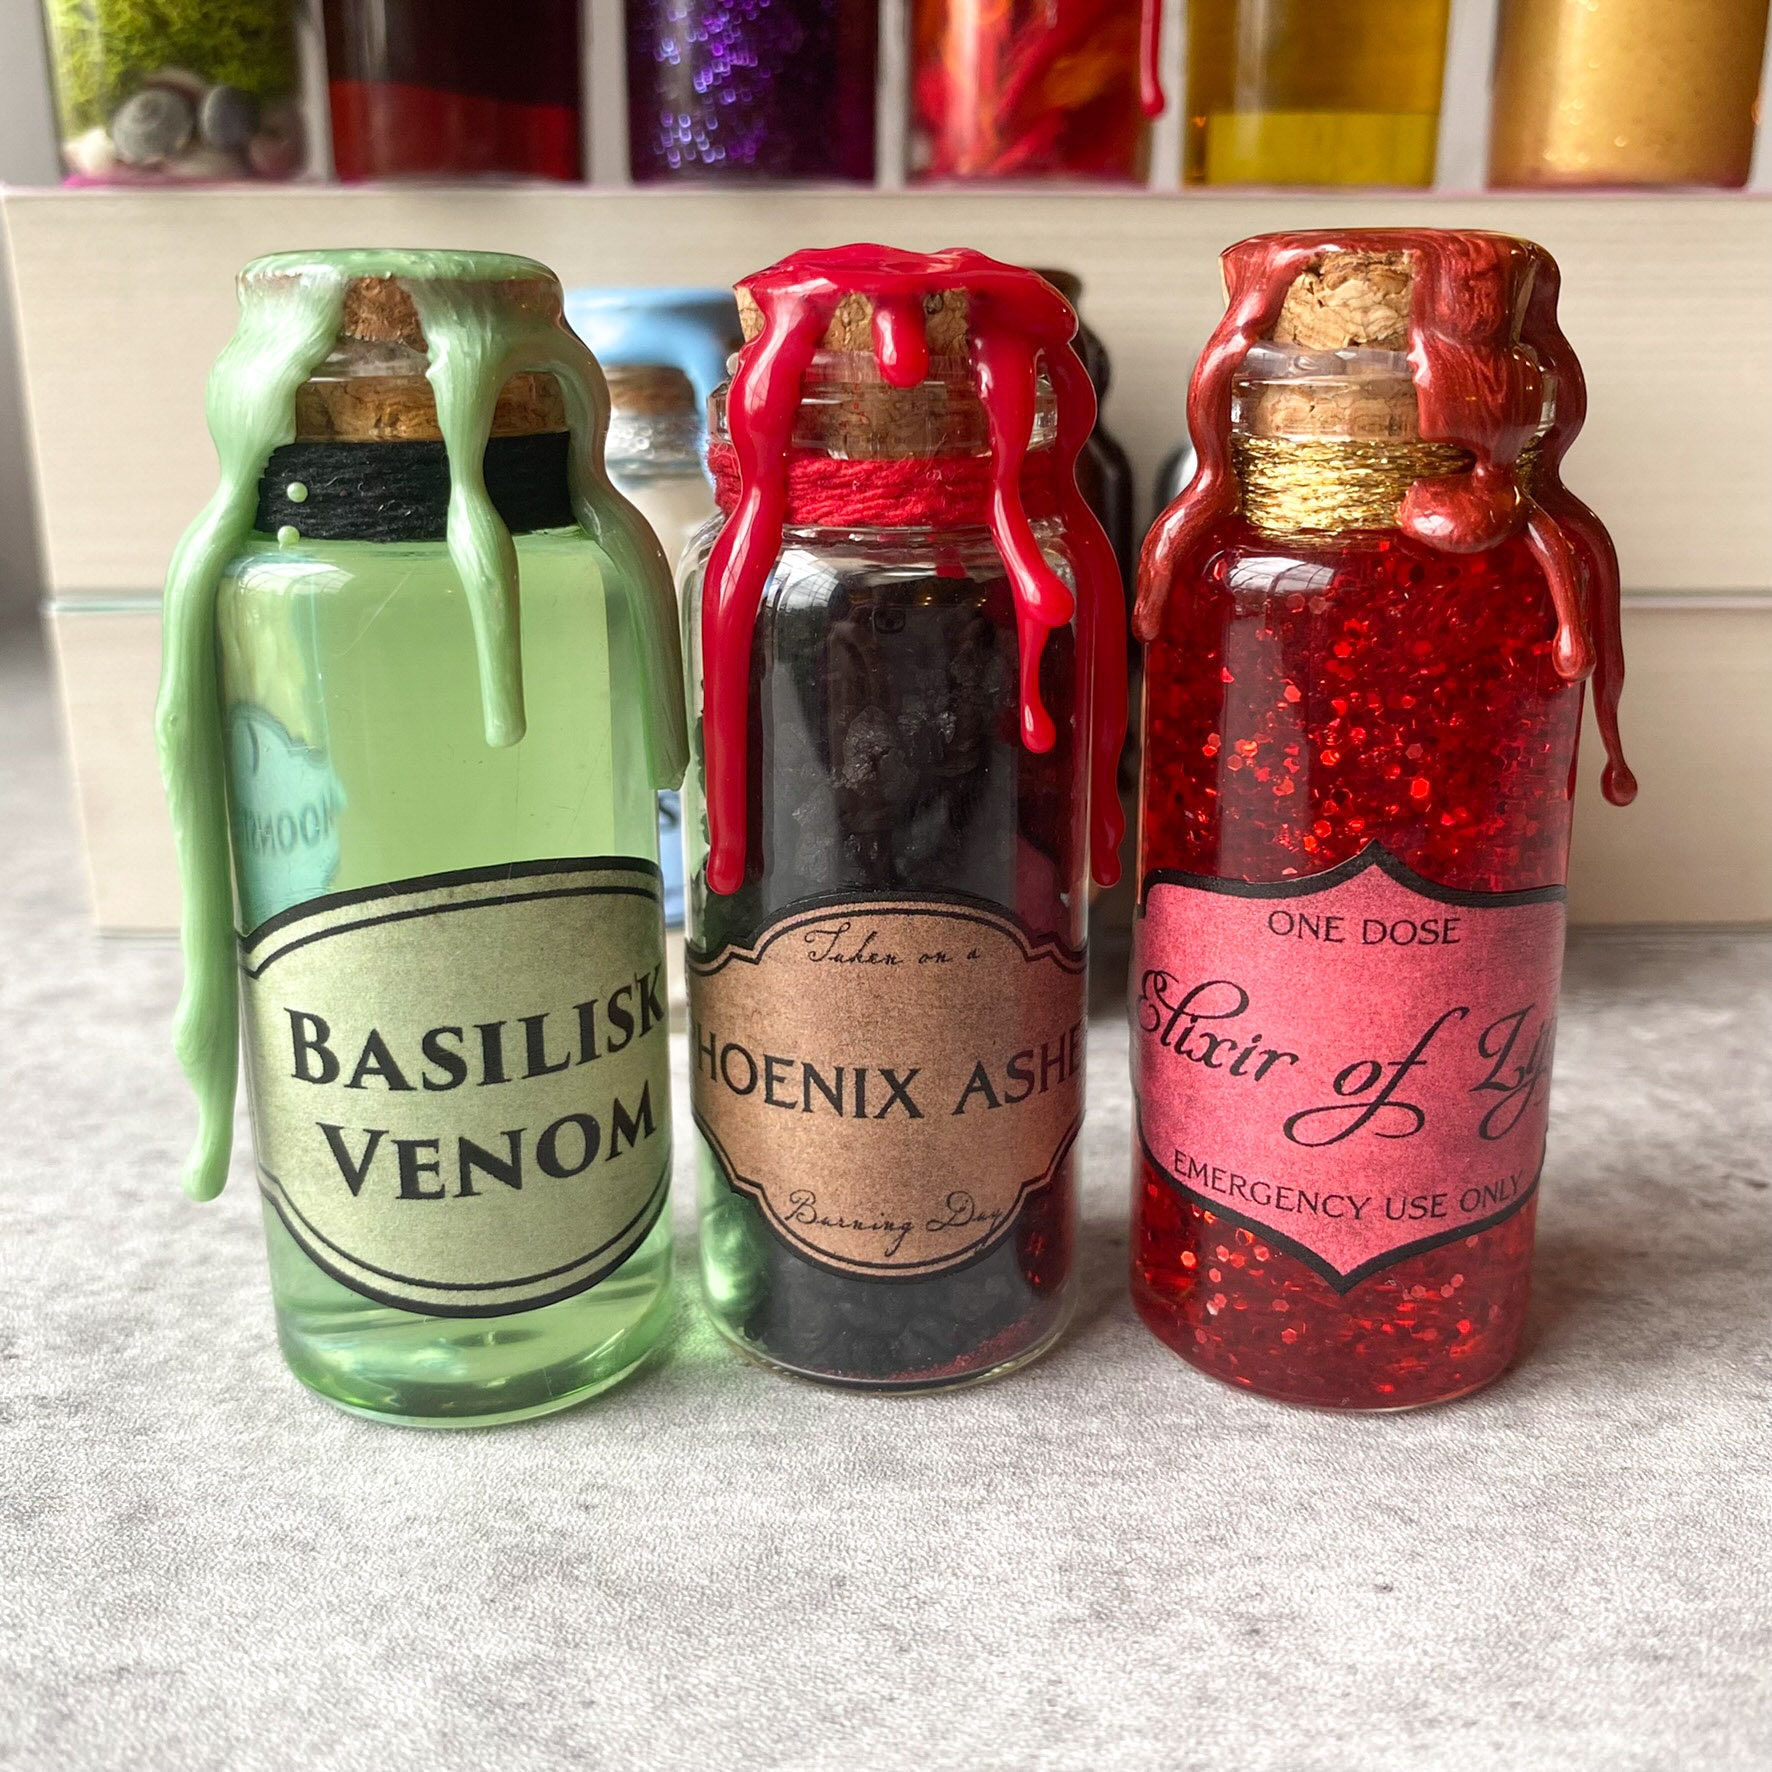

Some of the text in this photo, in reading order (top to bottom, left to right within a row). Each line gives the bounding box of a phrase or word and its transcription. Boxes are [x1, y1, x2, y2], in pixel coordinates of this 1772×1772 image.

[804, 921, 981, 966] Taken on a
[1267, 909, 1462, 946] ONE DOSE
[283, 960, 665, 1092] BASILISK
[692, 1018, 1084, 1120] HOENIX ASHE
[1138, 969, 1300, 1083] Elixir
[1282, 1006, 1470, 1148] of
[315, 1079, 658, 1201] VENOM
[784, 1189, 915, 1258] Burning
[1172, 1148, 1525, 1221] EMERGENCY USE ONLY
